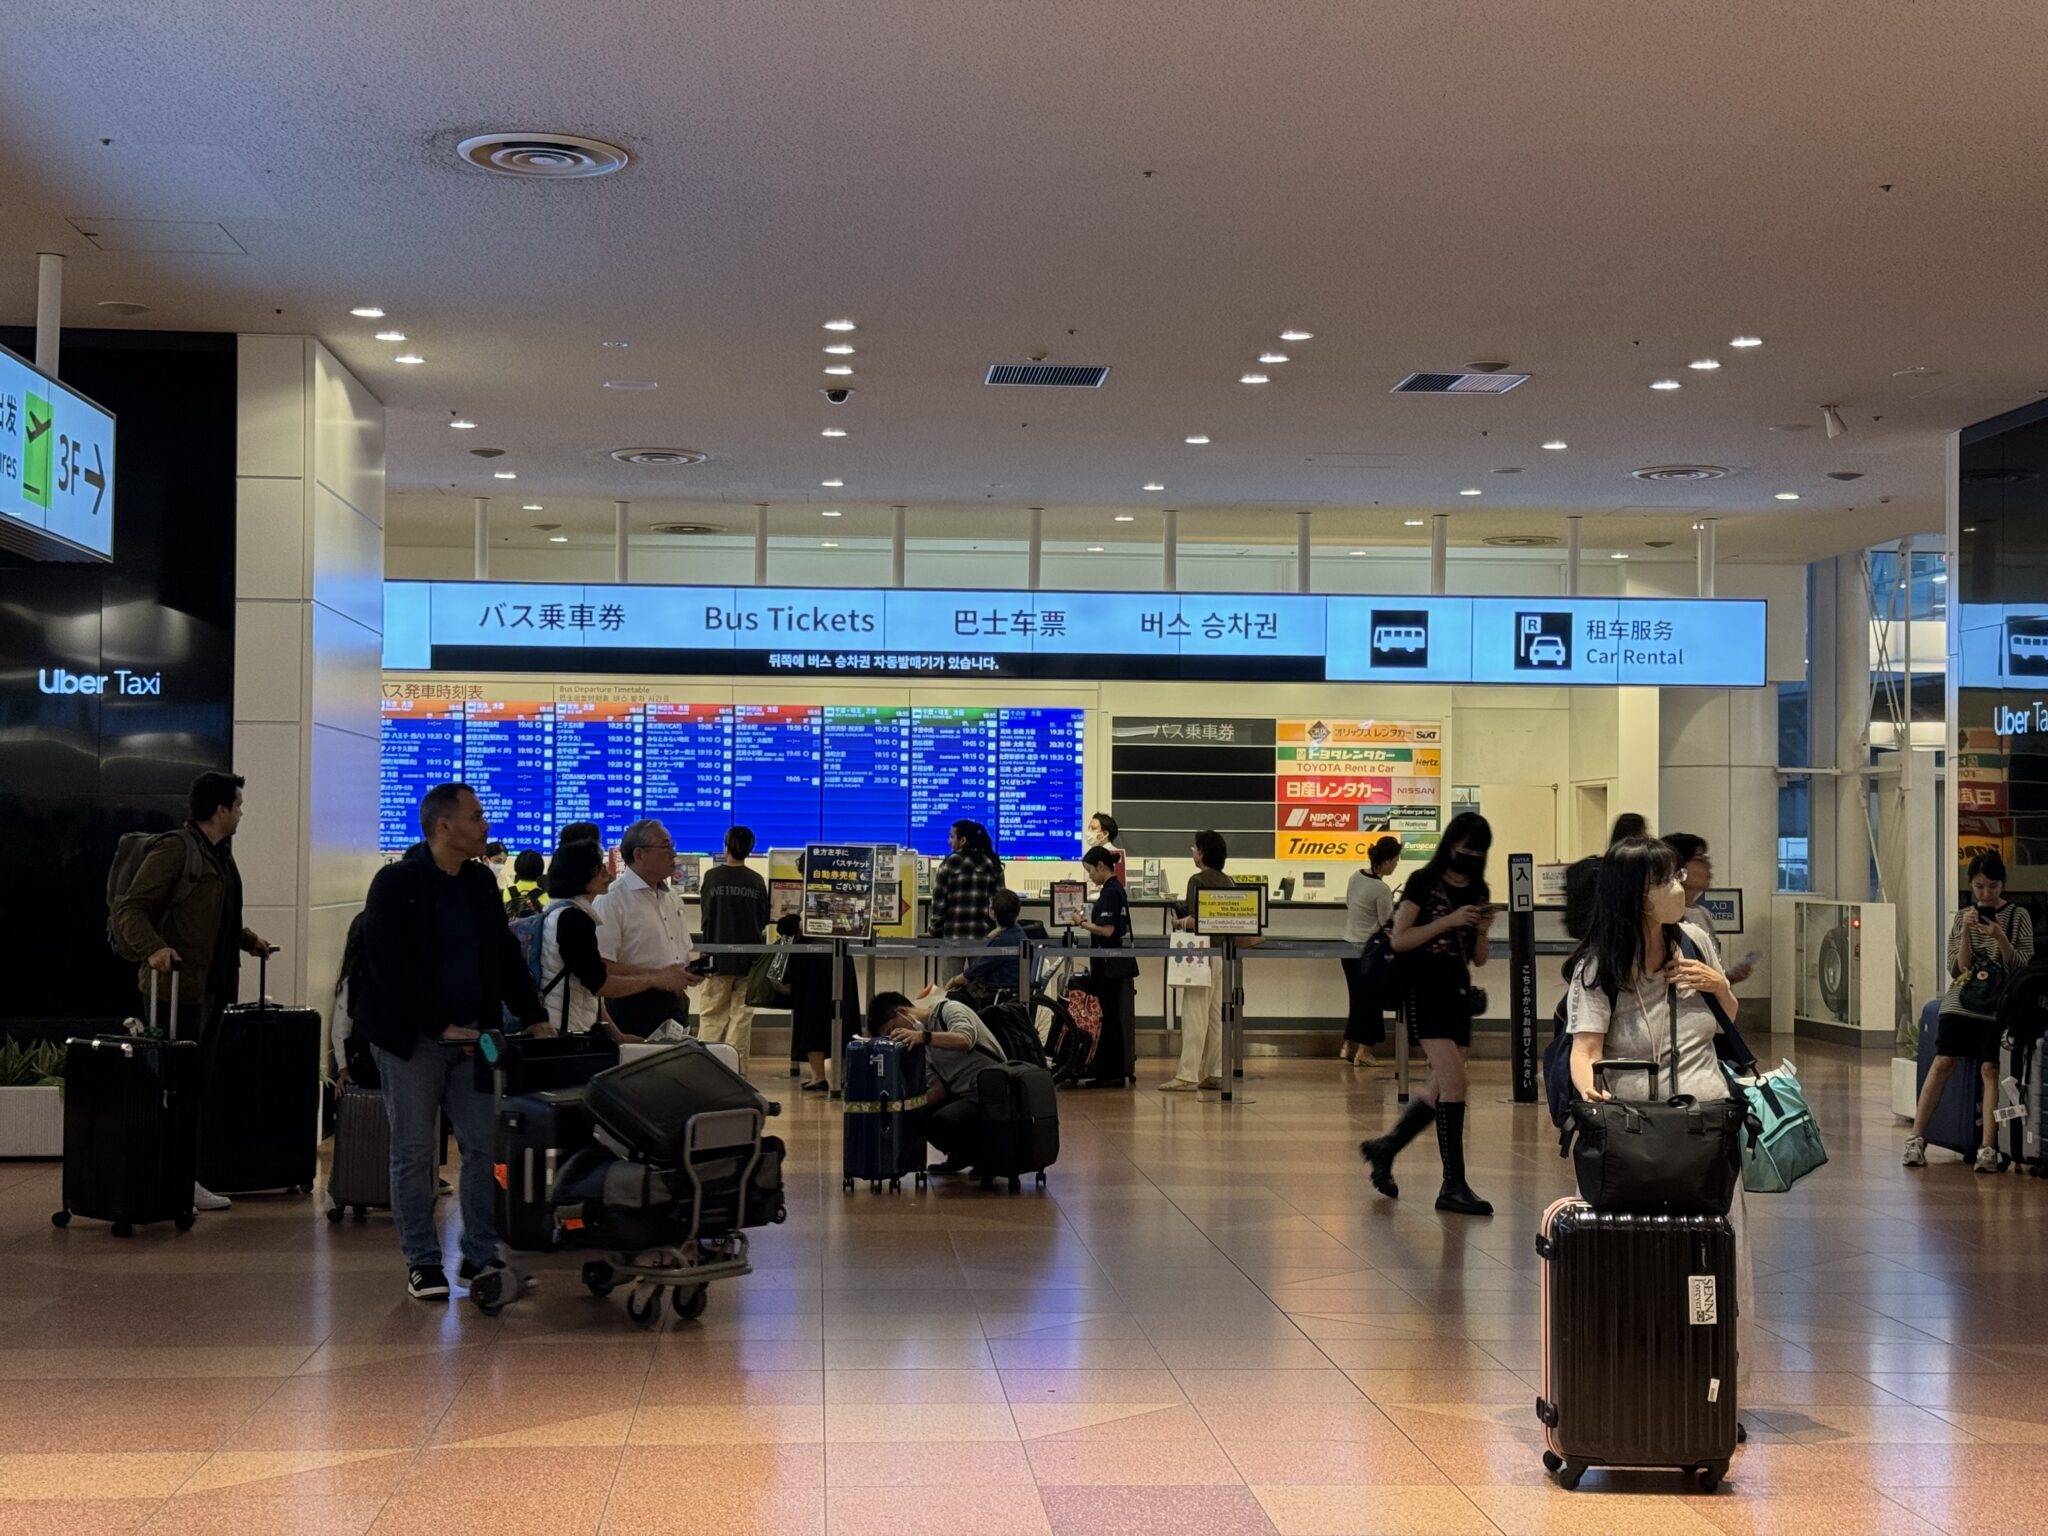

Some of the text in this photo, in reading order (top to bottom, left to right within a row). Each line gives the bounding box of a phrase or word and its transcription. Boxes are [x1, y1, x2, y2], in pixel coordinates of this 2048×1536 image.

[58, 434, 80, 495] 3F
[479, 602, 626, 631] バス乗車券
[705, 606, 875, 632] Bus Tickets
[955, 610, 1066, 636] 巴士车票
[1141, 612, 1278, 639] 버스 승차권
[1586, 620, 1673, 641] 租车服务
[768, 653, 999, 670] 뒤쪽에 버스 승차권 자동발매기가 있습니다.
[1587, 648, 1684, 665] Car Rental
[39, 669, 161, 695] Uber Taxi
[1994, 705, 2030, 736] Uber
[1153, 723, 1235, 741] バス乗車券
[1335, 727, 1412, 738] オリックス レンタカー
[1309, 748, 1395, 760] トヨタレンタカー
[1416, 758, 1439, 766] Hertz
[1297, 763, 1340, 772] TOYOTA
[1344, 764, 1367, 772] Rent
[1378, 764, 1395, 773] Car
[1287, 781, 1383, 798] 日産レンタカー
[1310, 813, 1350, 822] NIPPON
[813, 848, 850, 857] 後方左手に
[1289, 838, 1348, 854] Times
[832, 859, 870, 868] バスチケット
[836, 882, 869, 891] ございます
[1516, 867, 1530, 908] 入口
[1712, 902, 1727, 910] 入口
[1522, 964, 1533, 1089] こちらからお並びください
[1704, 1278, 1714, 1322] SENNA
